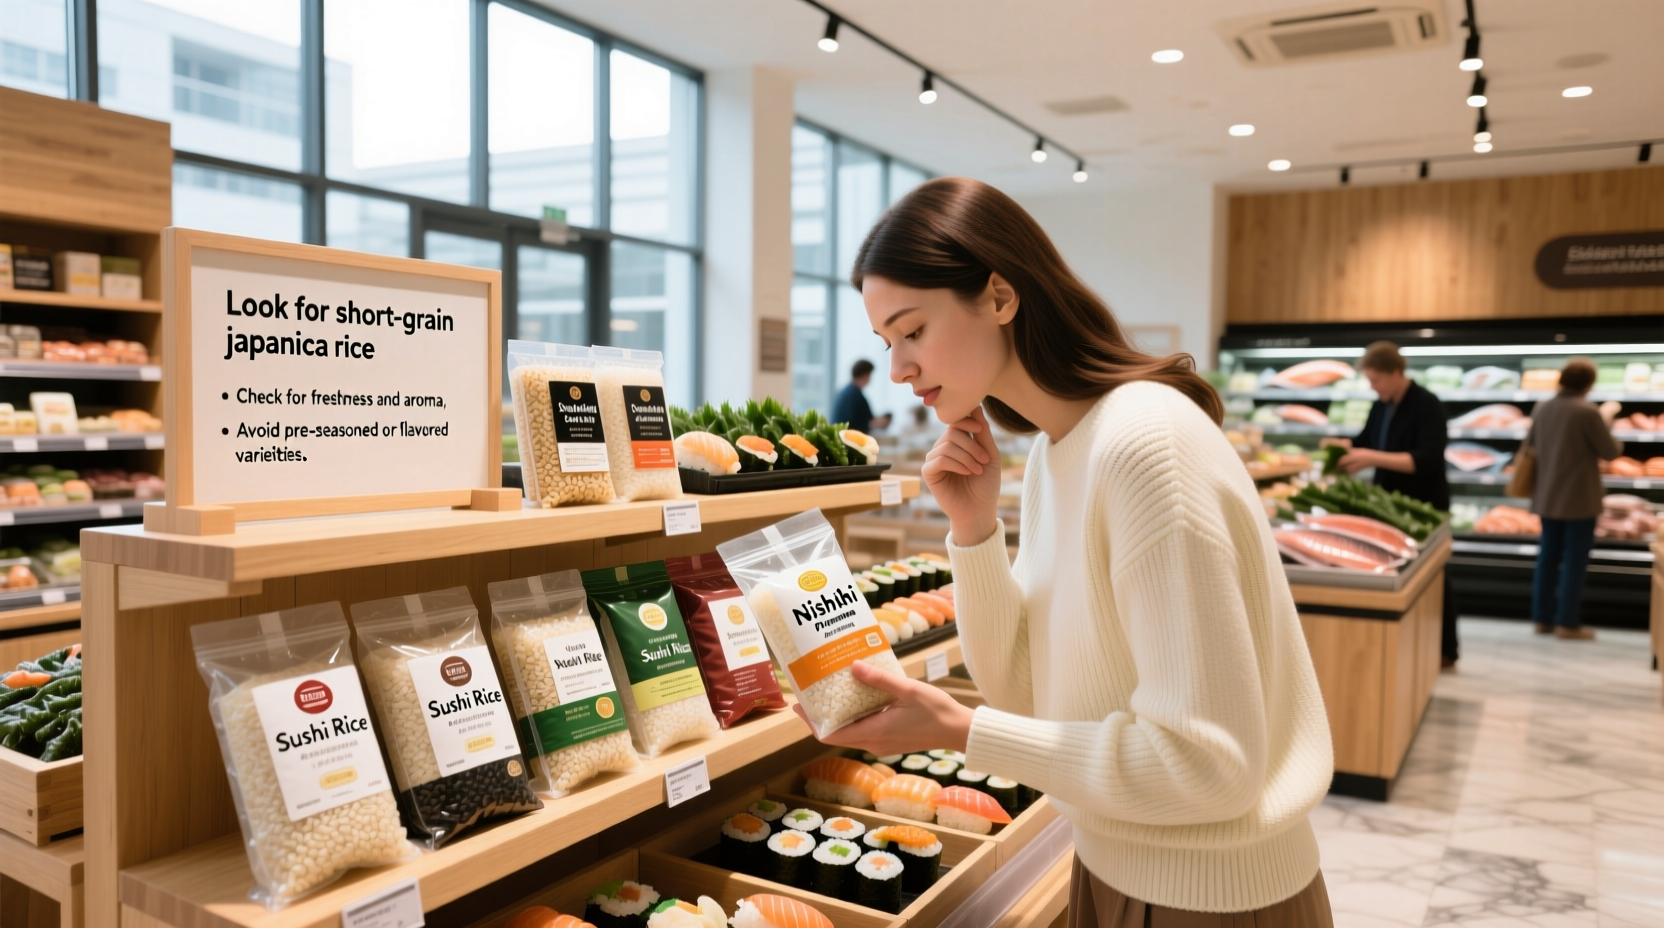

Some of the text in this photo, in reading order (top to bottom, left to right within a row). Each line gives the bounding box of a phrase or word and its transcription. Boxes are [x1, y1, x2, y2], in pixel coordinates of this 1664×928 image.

[226, 289, 454, 335] Look for short-grain
[223, 326, 376, 361] japanica rice
[236, 388, 283, 405] Check
[285, 389, 307, 405] for
[376, 391, 400, 407] and
[403, 396, 447, 409] aroma,
[236, 421, 280, 438] Avoid
[284, 421, 379, 441] pre-seasoned
[382, 425, 398, 438] or
[428, 693, 472, 719] Sushi
[473, 688, 503, 707] Rice
[275, 721, 330, 753] Sushi
[331, 715, 369, 737] Rice
